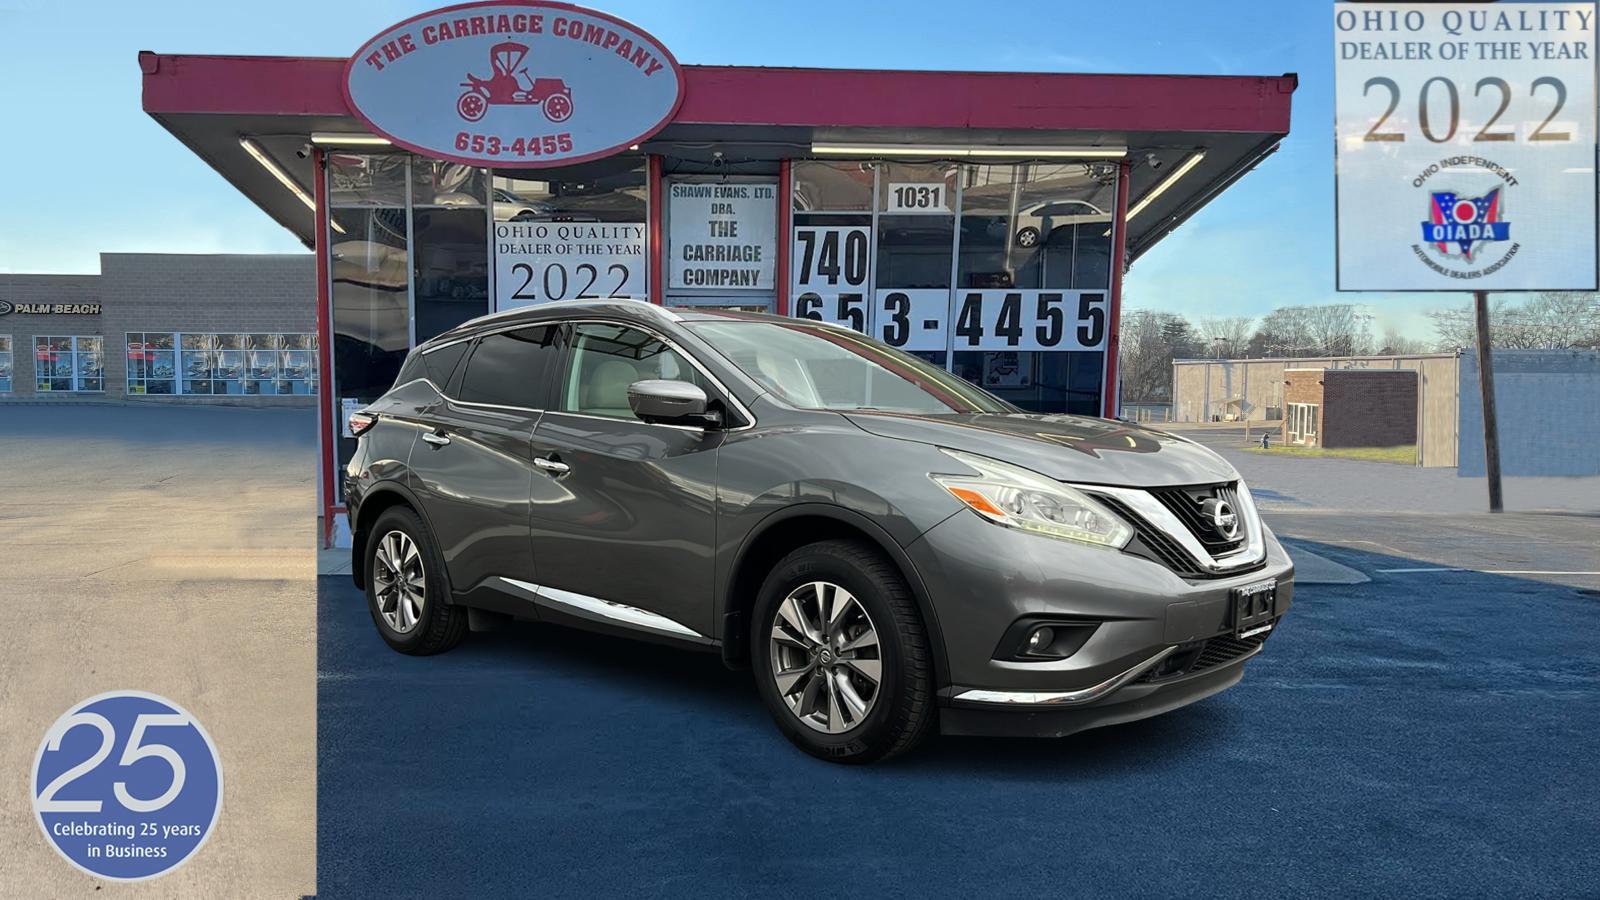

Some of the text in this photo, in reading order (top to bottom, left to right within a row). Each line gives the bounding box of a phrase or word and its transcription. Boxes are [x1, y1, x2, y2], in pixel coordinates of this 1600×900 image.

[1337, 10, 1592, 36] OHIO QUALITY
[366, 14, 664, 77] THE CARRIAGE COMPANY
[1341, 42, 1589, 60] DEALER OF THE YEAR
[1363, 76, 1570, 143] 2022
[454, 131, 573, 157] 653-4455
[1412, 156, 1519, 188] OHIO INDEPENDENT
[672, 186, 711, 199] SHAWN
[754, 187, 775, 199] LTD.
[894, 187, 940, 209] 1031
[711, 203, 736, 215] DBA.
[497, 226, 644, 241] OHIO QUALITY
[708, 220, 737, 237] THE
[1432, 224, 1495, 240] OIADA
[499, 243, 641, 255] DEALER OF THE YEAR
[683, 244, 762, 262] CARRIAGE
[797, 230, 868, 286] 740
[1410, 242, 1520, 280] AUTOMOBILE DEALERS ASSOCIATION
[511, 263, 631, 300] 2022
[683, 268, 760, 287] COMPANY
[14, 303, 51, 314] PALM
